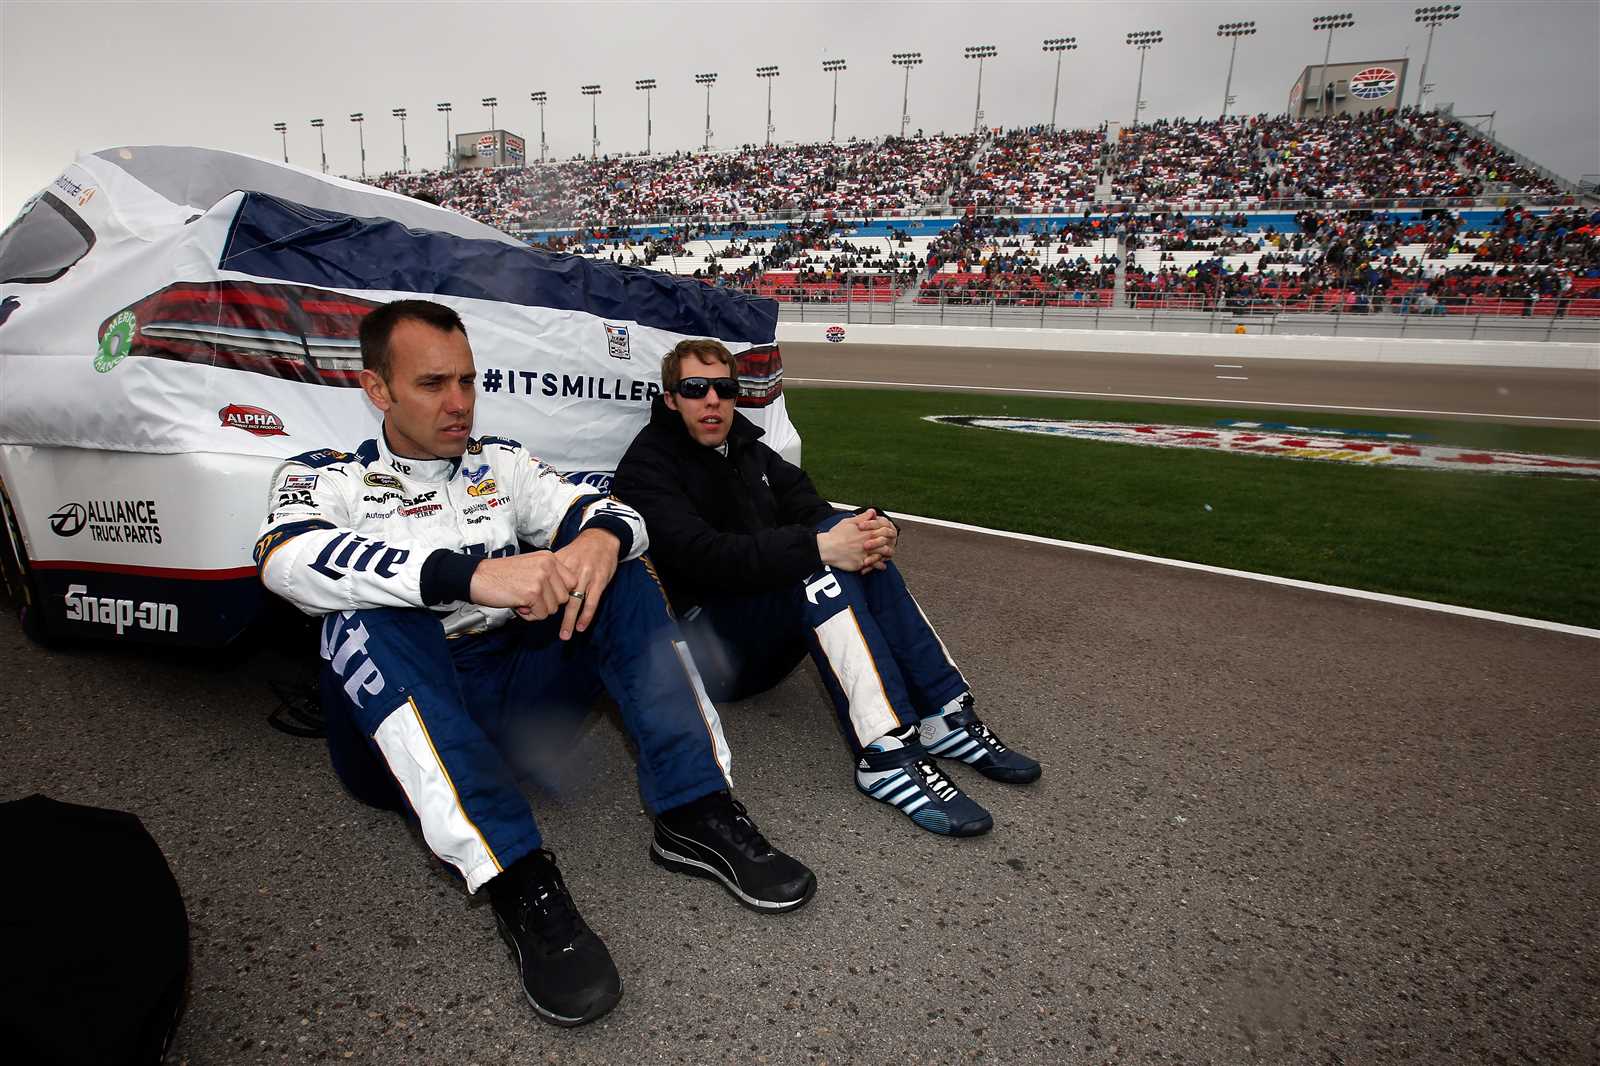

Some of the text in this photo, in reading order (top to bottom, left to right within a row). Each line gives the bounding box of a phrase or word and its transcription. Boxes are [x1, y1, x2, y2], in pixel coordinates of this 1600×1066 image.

[226, 413, 277, 426] ALPHA
[88, 501, 158, 524] ALLIANCE
[90, 525, 162, 545] TRUCK PARTS
[307, 531, 410, 581] Lite
[65, 583, 179, 635] Snap-on
